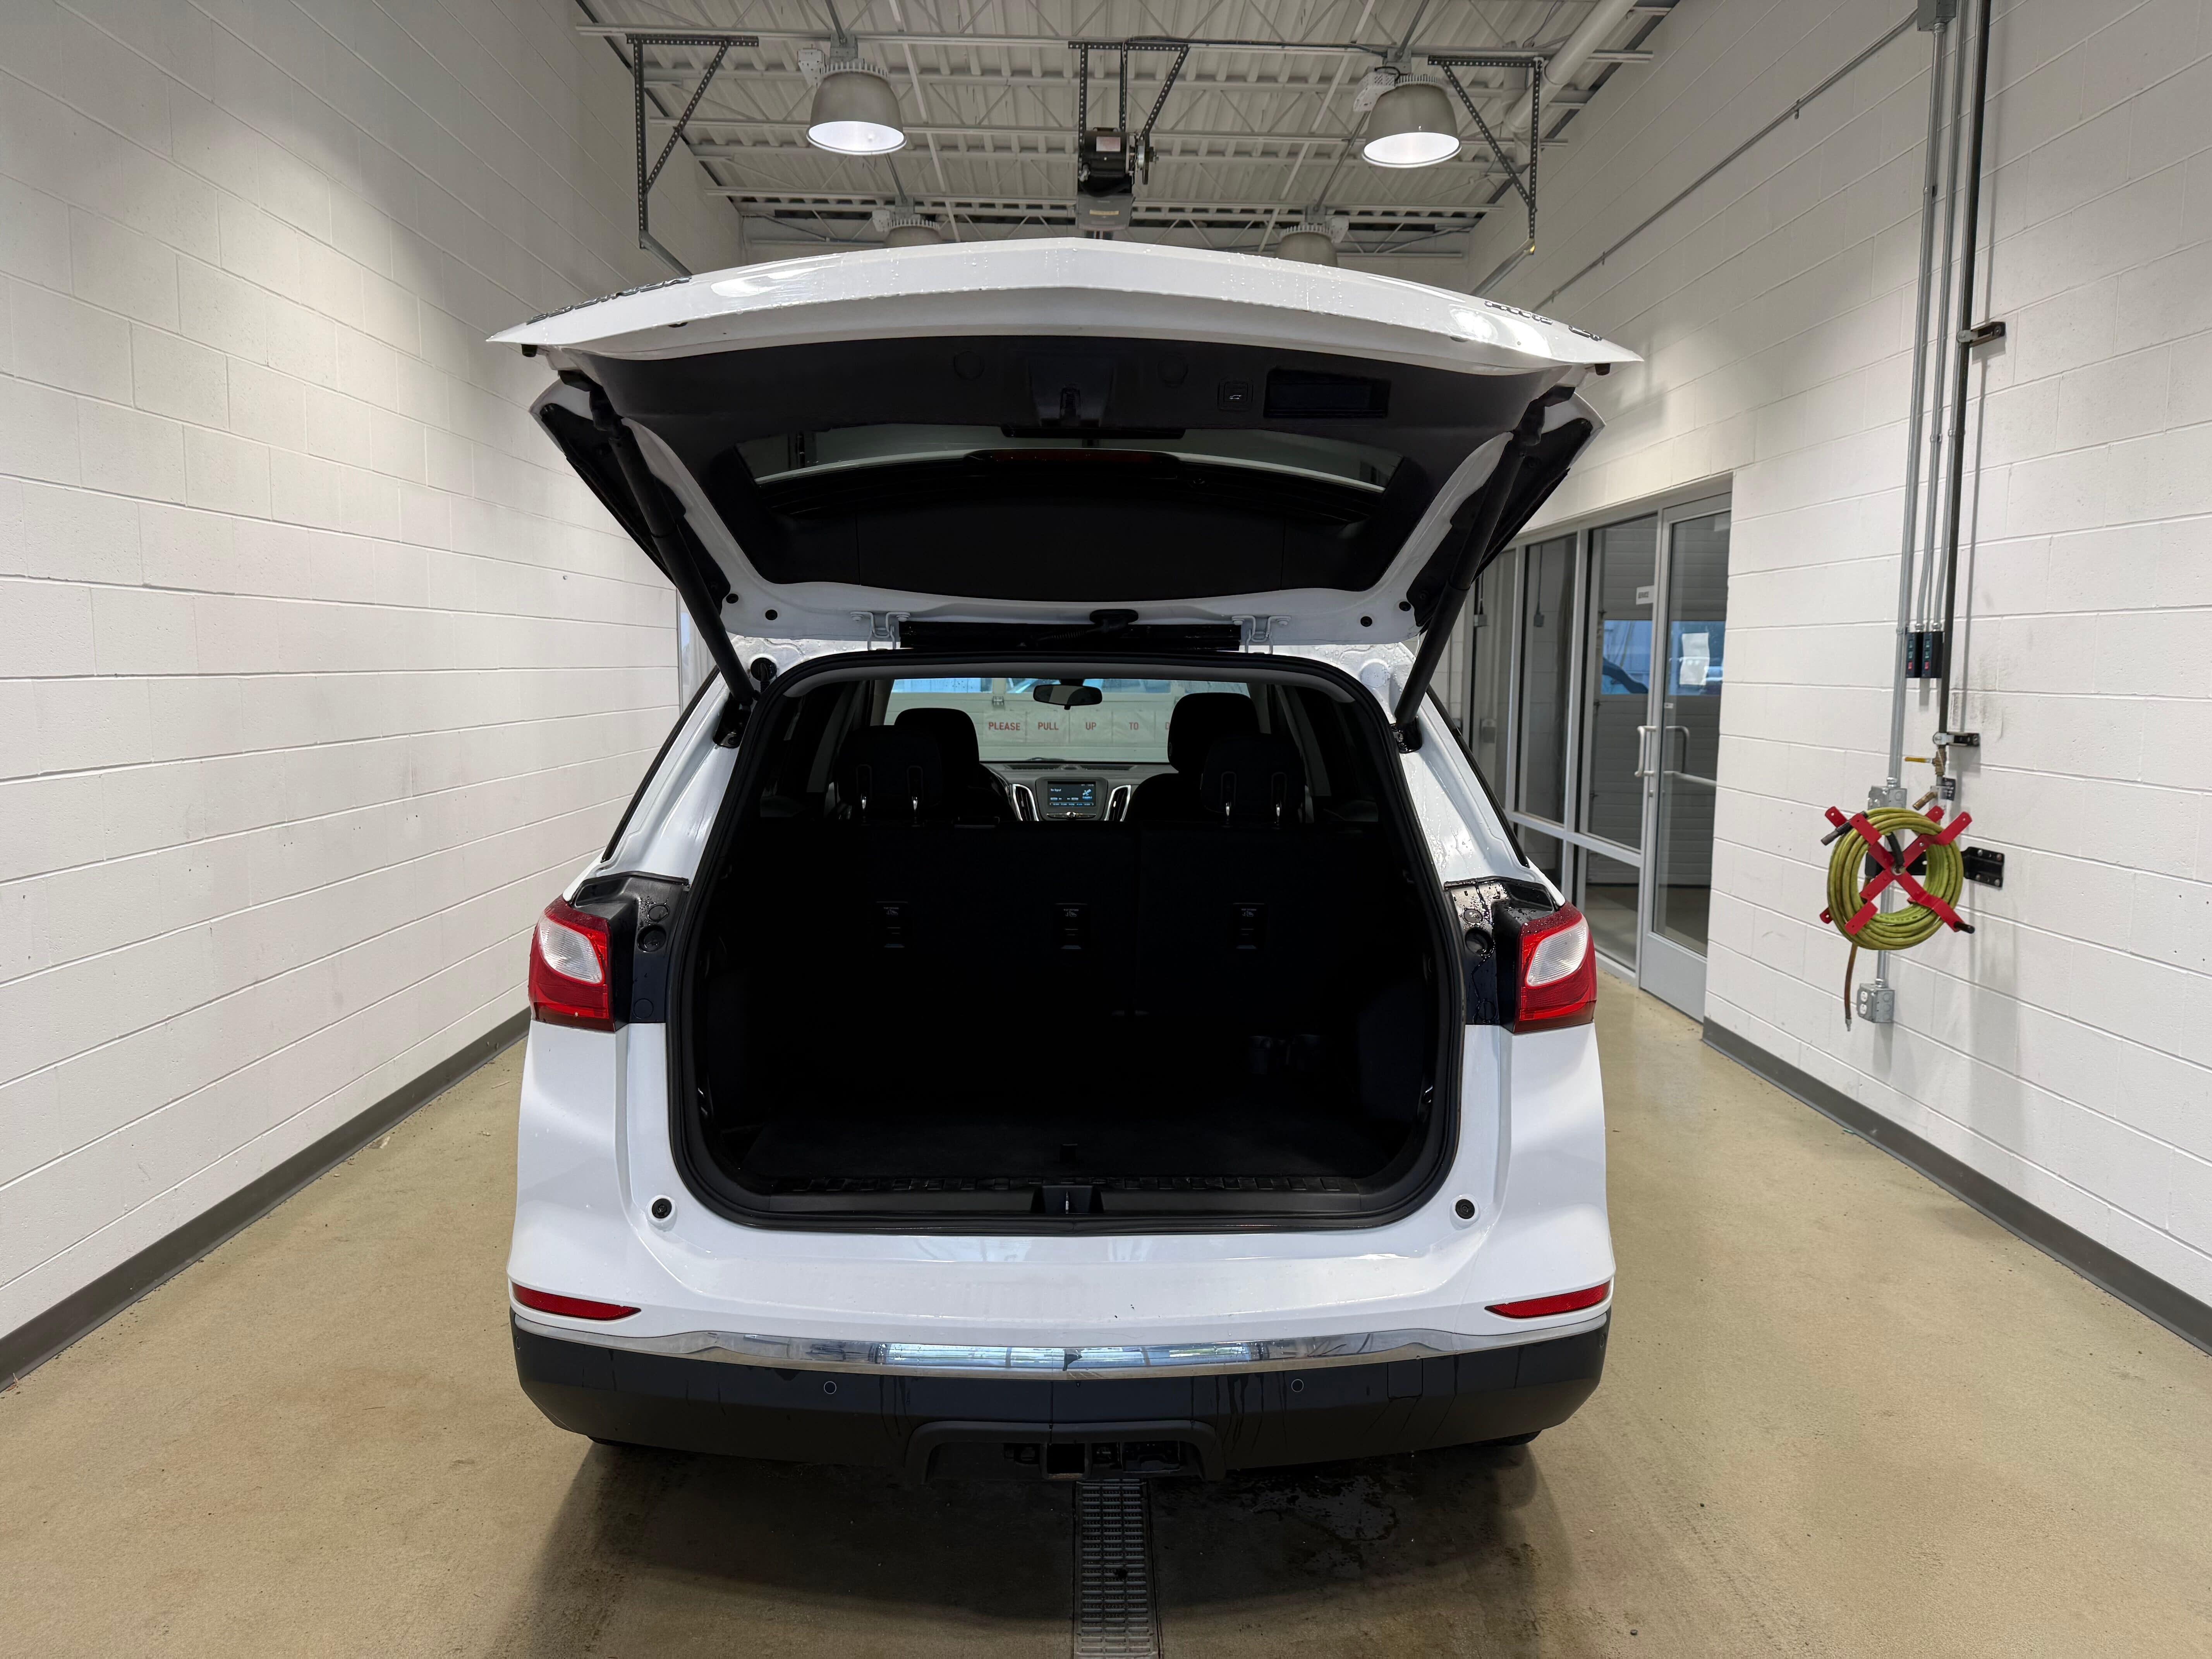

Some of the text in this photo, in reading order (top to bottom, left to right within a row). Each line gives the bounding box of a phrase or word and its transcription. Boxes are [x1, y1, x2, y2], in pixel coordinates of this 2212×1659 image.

[988, 722, 1020, 731] PLEASE
[1038, 722, 1058, 730] PULL
[1085, 722, 1096, 730] UP
